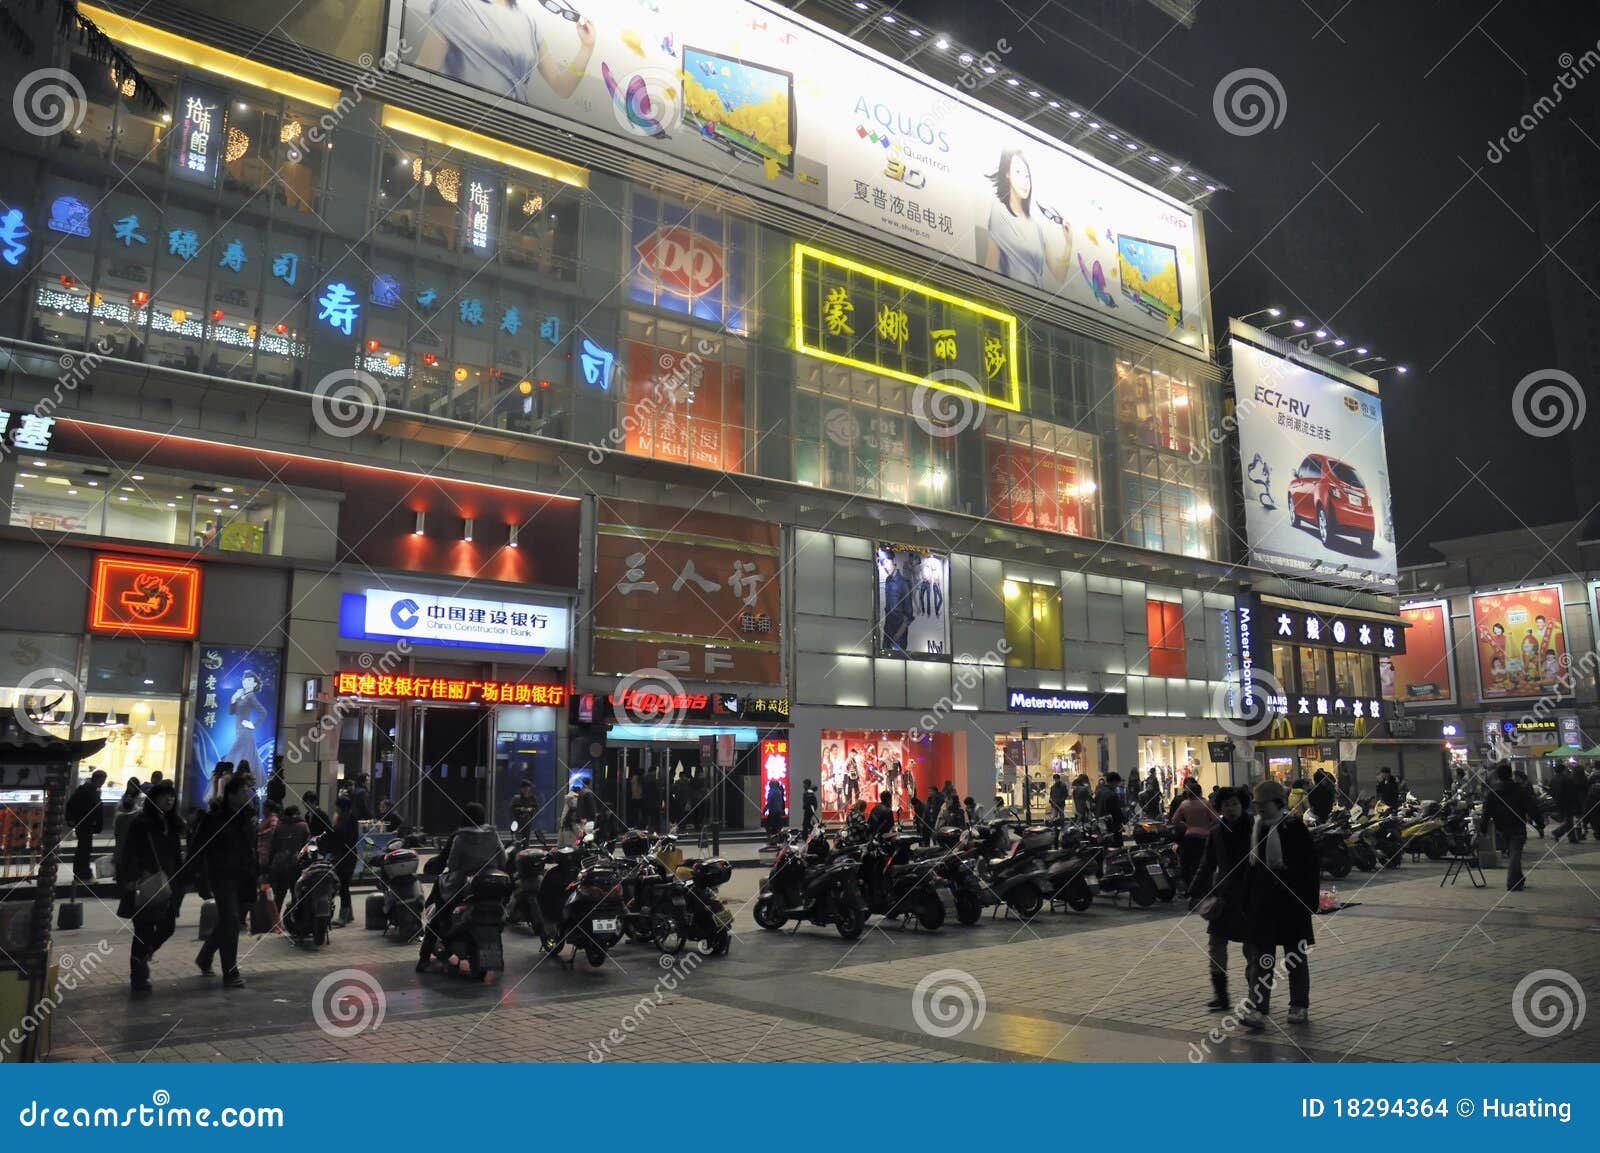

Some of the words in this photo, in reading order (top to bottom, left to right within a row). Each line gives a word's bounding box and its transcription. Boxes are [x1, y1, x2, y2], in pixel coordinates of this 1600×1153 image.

[854, 96, 950, 153] AQUOS
[903, 145, 950, 173] Quattron
[854, 179, 954, 236] 夏普液晶电视
[656, 237, 718, 284] DQ
[823, 286, 1006, 379] 蒙娜丽莎
[1254, 385, 1311, 419] EC7-RV
[616, 552, 765, 608] 三人行
[427, 605, 548, 629] 中国建设银行
[427, 620, 452, 631] China
[454, 622, 508, 635] Construction
[511, 627, 532, 637] Bank
[657, 650, 735, 674] 2F
[339, 673, 563, 705] 国建设银行佳丽广场自助银行
